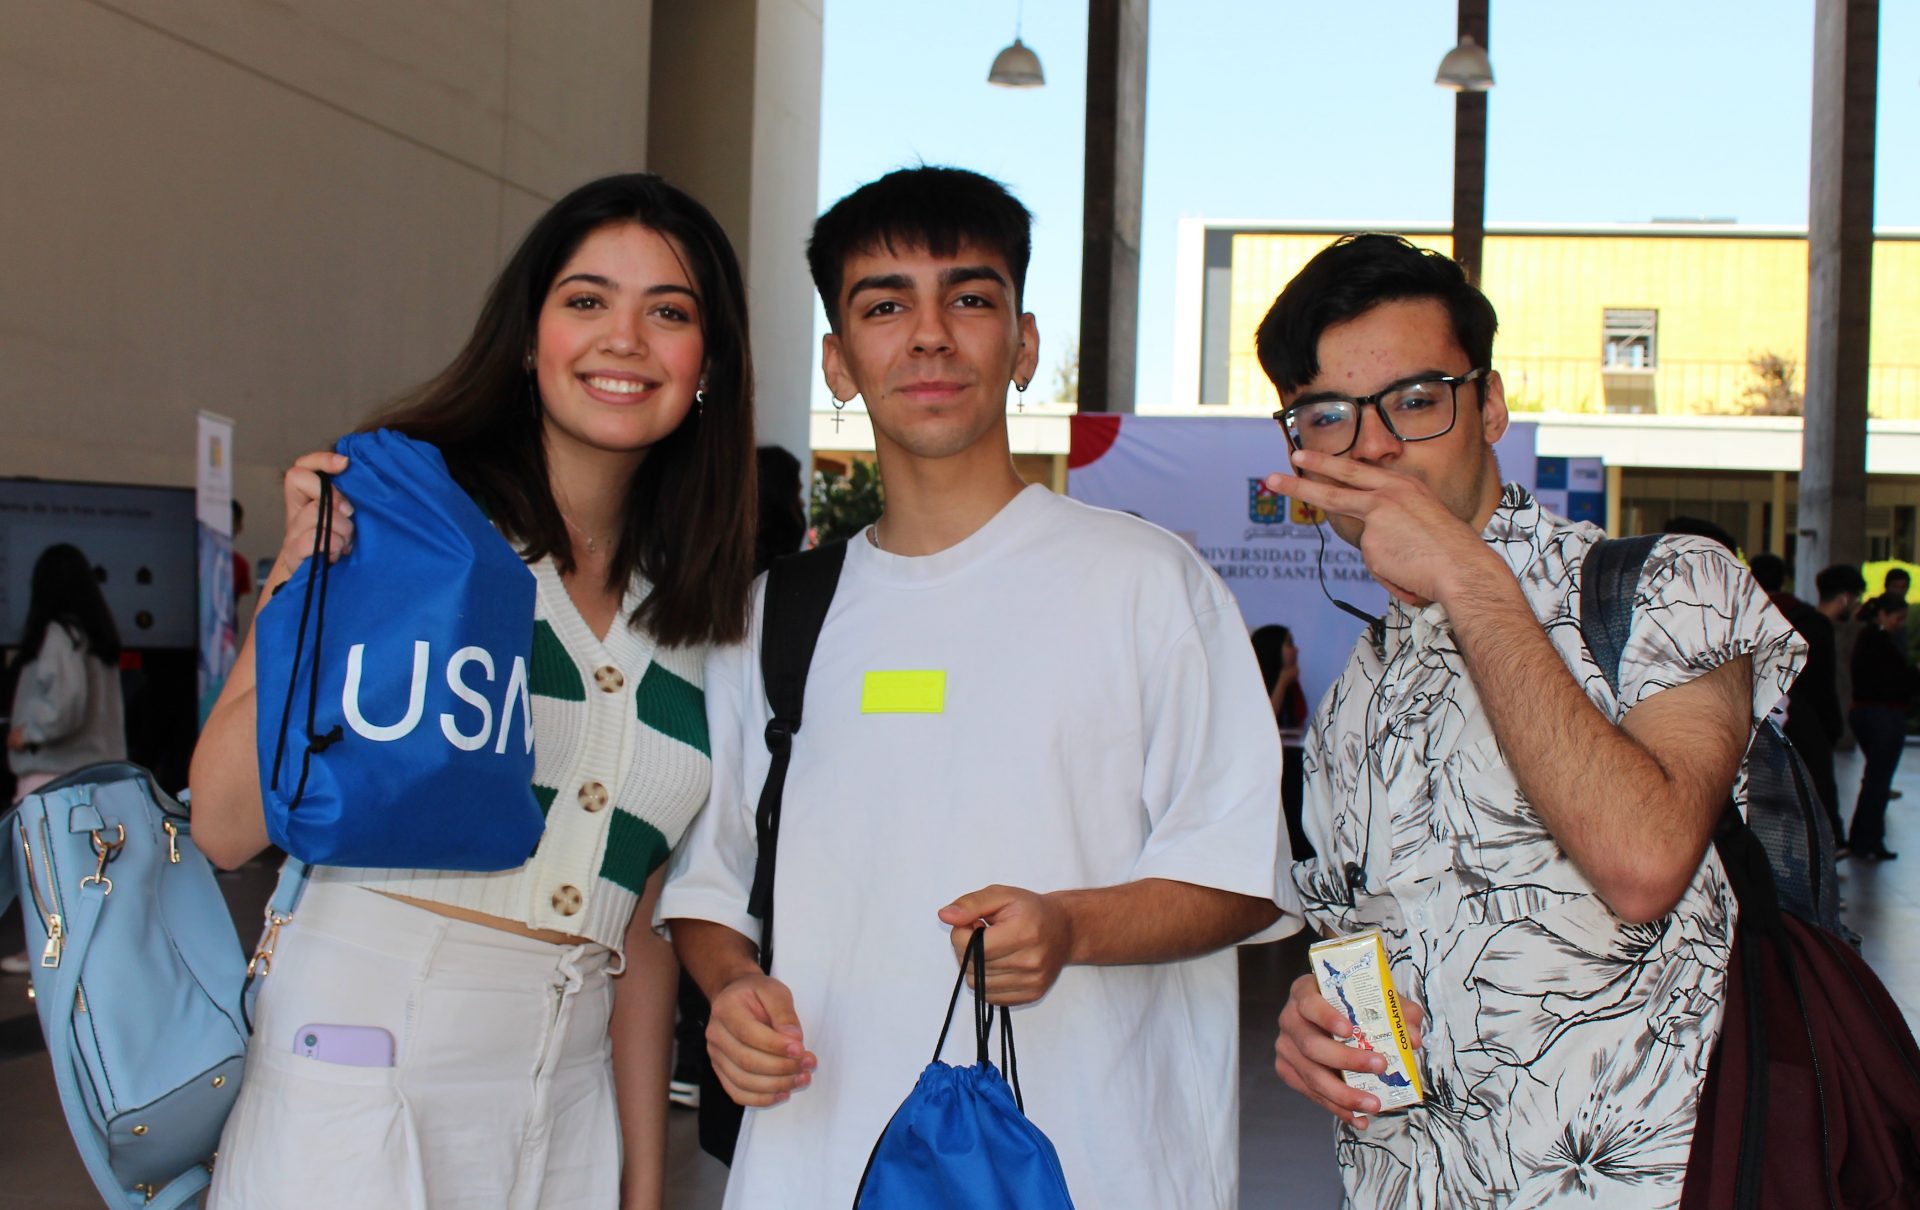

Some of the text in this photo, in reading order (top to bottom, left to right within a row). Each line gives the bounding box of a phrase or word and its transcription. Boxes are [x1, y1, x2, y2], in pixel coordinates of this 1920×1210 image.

[1198, 547, 1305, 563] NIVERSIDAD
[1273, 566, 1327, 581] SANTA
[1332, 567, 1376, 583] MAR
[1399, 1030, 1408, 1050] CON
